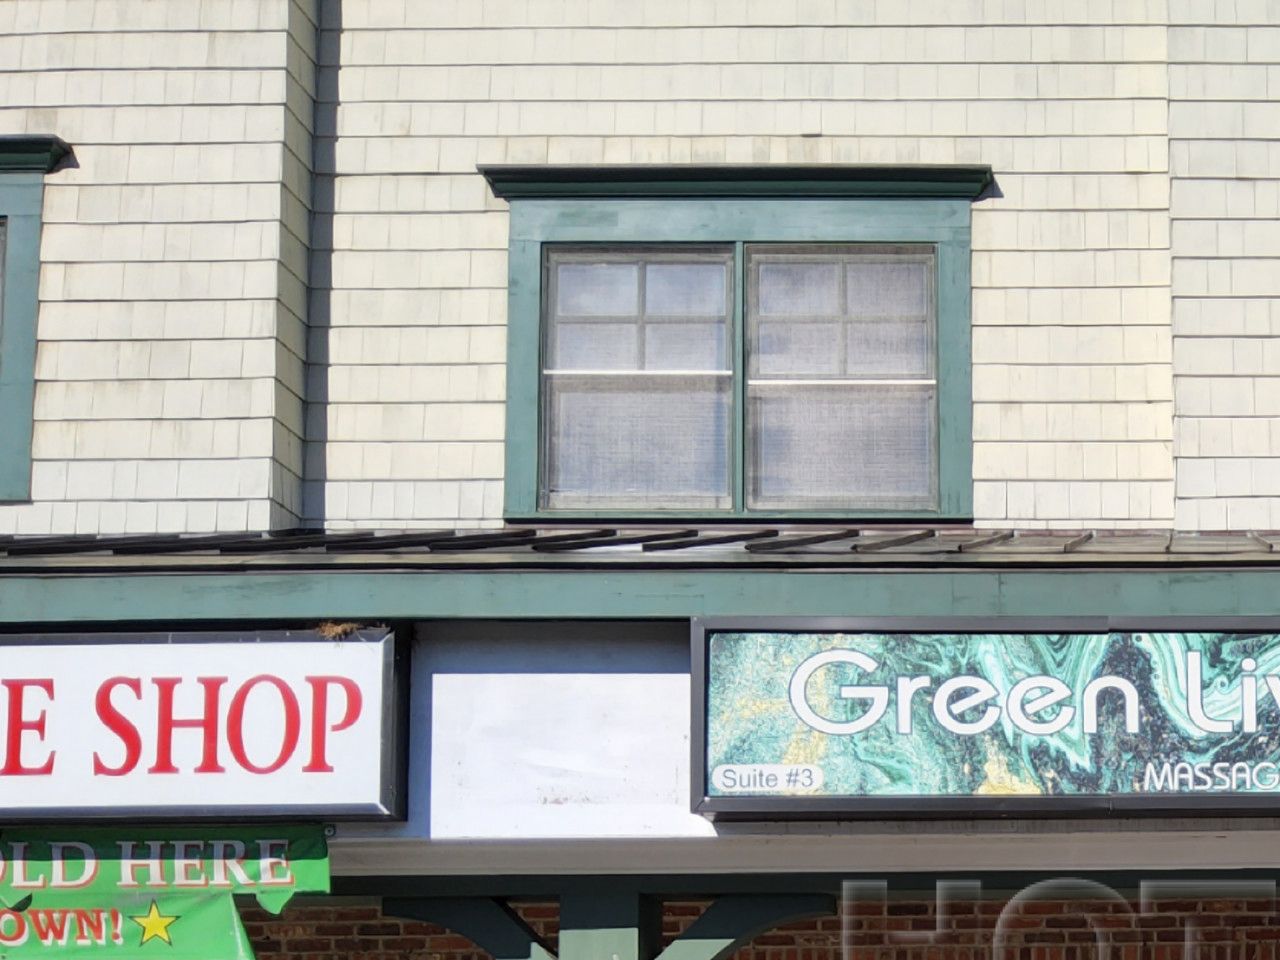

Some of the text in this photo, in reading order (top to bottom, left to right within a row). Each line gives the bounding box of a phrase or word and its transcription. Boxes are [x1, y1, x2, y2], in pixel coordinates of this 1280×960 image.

[0, 675, 363, 776] E SHOP
[789, 648, 1140, 735] Green
[721, 768, 814, 789] Suite #3
[0, 839, 296, 889] LD HERE
